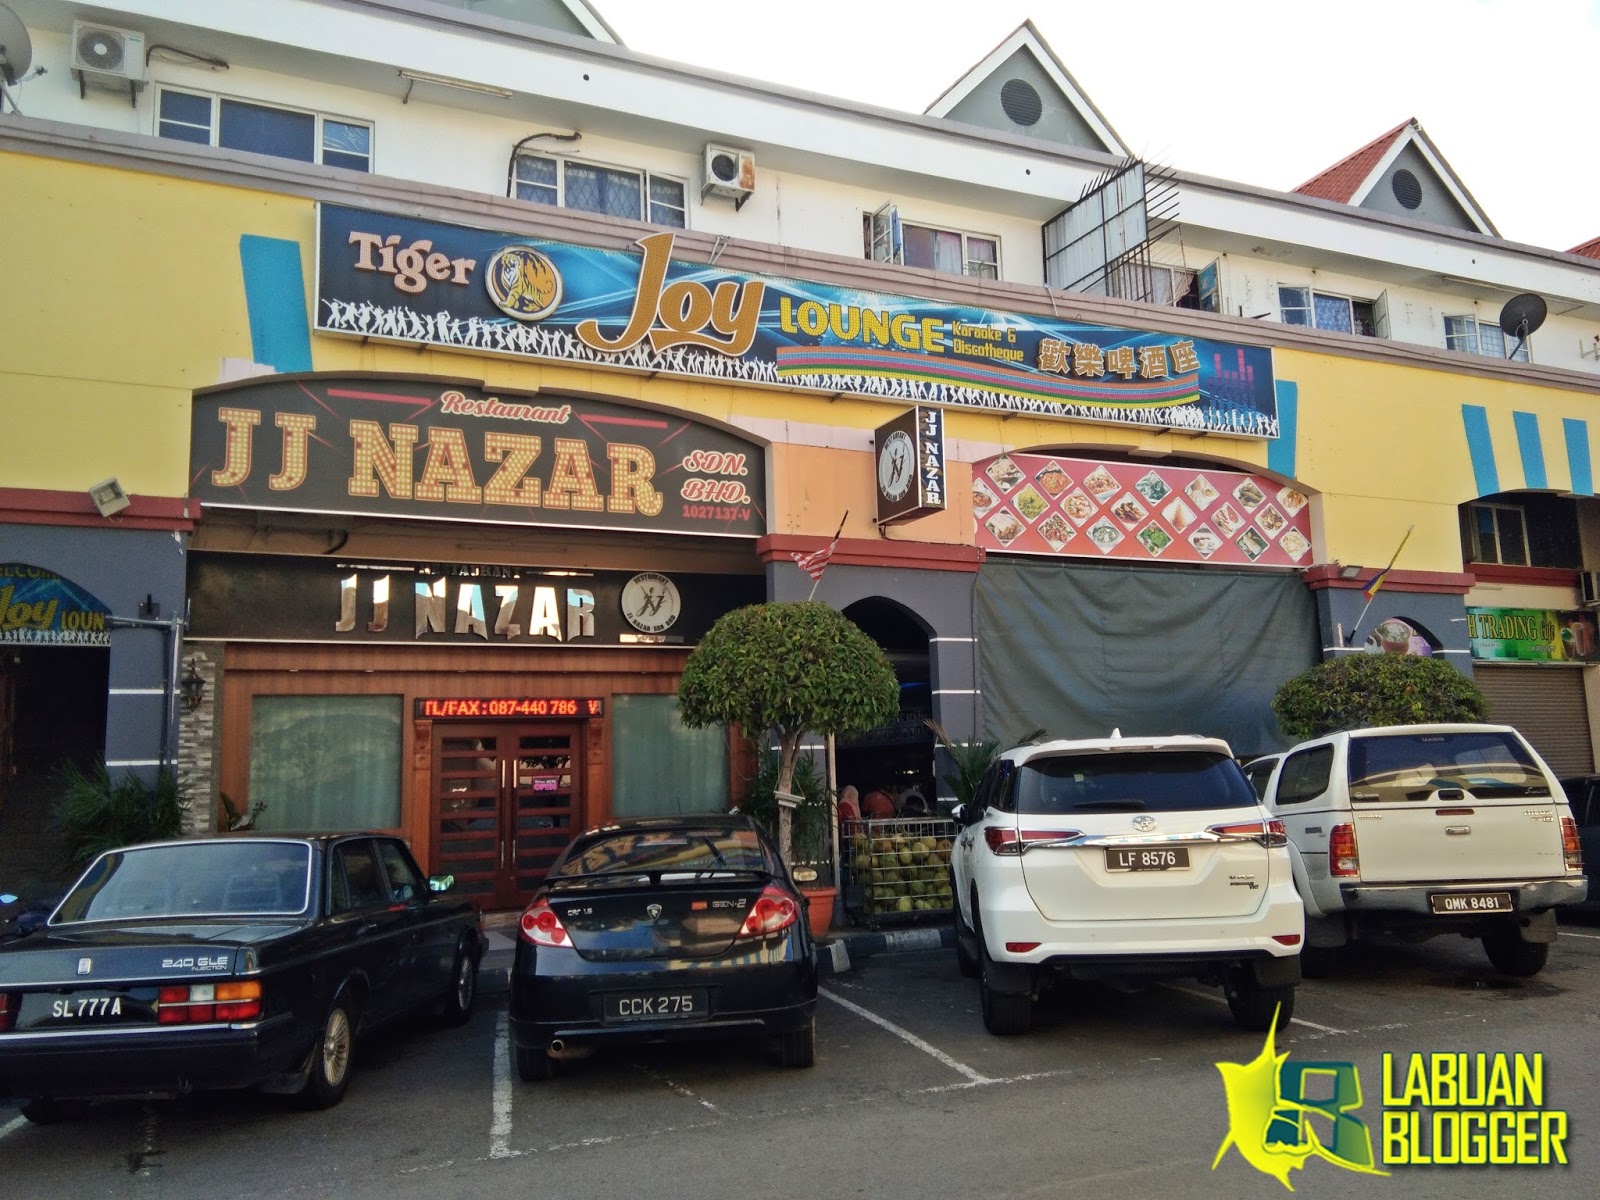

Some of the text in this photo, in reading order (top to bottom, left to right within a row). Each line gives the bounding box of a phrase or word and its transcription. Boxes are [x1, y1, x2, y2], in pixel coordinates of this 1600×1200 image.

[348, 231, 477, 294] Tiger
[575, 232, 945, 357] Joy LOUNGE
[952, 321, 1002, 341] Karaoke
[953, 338, 1024, 363] Discotheque
[1038, 338, 1200, 380] 歡樂啤酒座
[441, 390, 571, 424] Restaurant
[348, 419, 664, 517] NAZAR
[682, 449, 748, 476] SDN.
[925, 442, 941, 504] NAZAR
[680, 478, 751, 505] BHD.
[682, 504, 751, 521] 1027137-V
[415, 576, 595, 642] NAZAR
[1479, 614, 1537, 640] TRADING
[550, 700, 578, 716] 786
[1119, 851, 1176, 866] LF 8576
[1445, 896, 1499, 910] QMK 8481
[162, 956, 228, 968] 240 GLE
[52, 1000, 74, 1018] SL
[619, 995, 693, 1015] CCK 275
